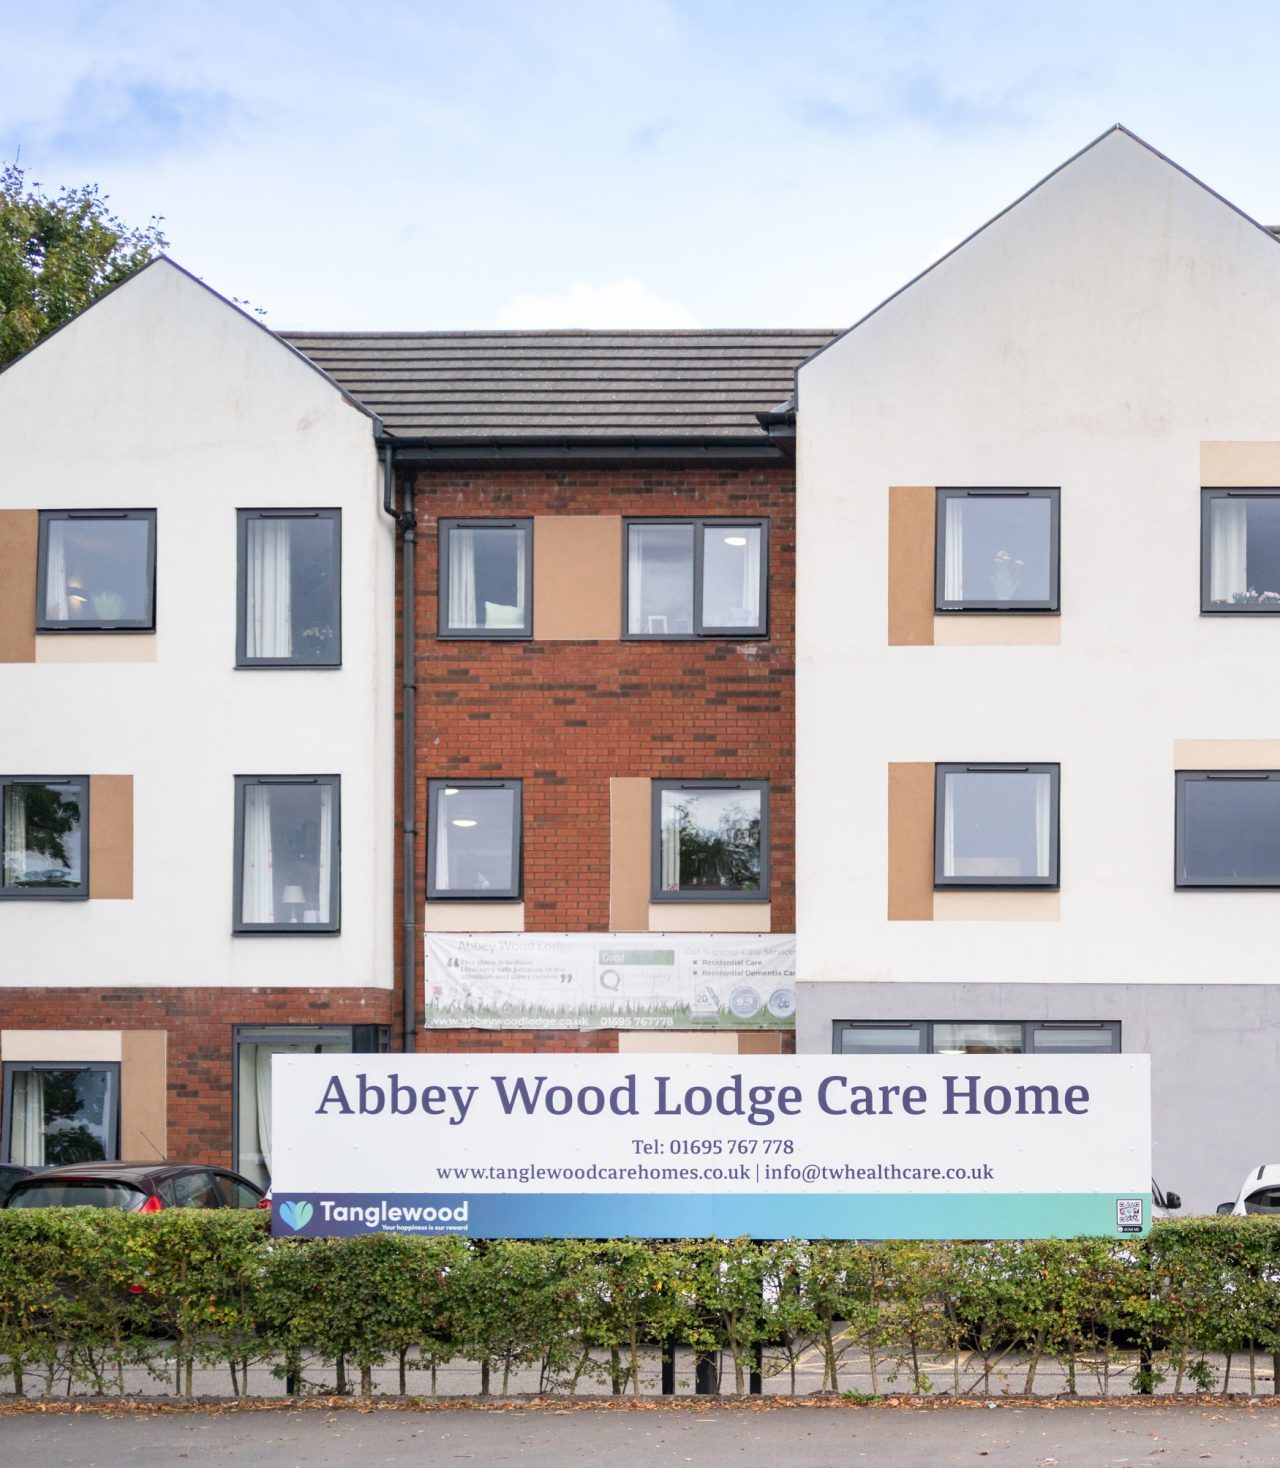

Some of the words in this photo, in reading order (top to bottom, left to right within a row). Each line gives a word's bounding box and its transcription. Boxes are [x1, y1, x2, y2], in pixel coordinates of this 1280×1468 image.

[602, 952, 625, 962] Good
[600, 1017, 632, 1027] 01695
[314, 1073, 480, 1126] Abbey
[490, 1073, 640, 1116] Wood
[654, 1073, 803, 1126] Lodge
[817, 1075, 927, 1116] Care
[941, 1075, 1090, 1115] Home
[631, 1138, 664, 1155] Tel:
[669, 1139, 723, 1155] 01695
[727, 1139, 758, 1155] 767
[762, 1139, 794, 1155] 778
[436, 1163, 751, 1184] www.tanglewoodcarehomes.co.uk
[765, 1163, 994, 1184] info@twhealthcare.co.uk
[320, 1200, 469, 1228] Tanglewood
[396, 1224, 428, 1232] happiness
